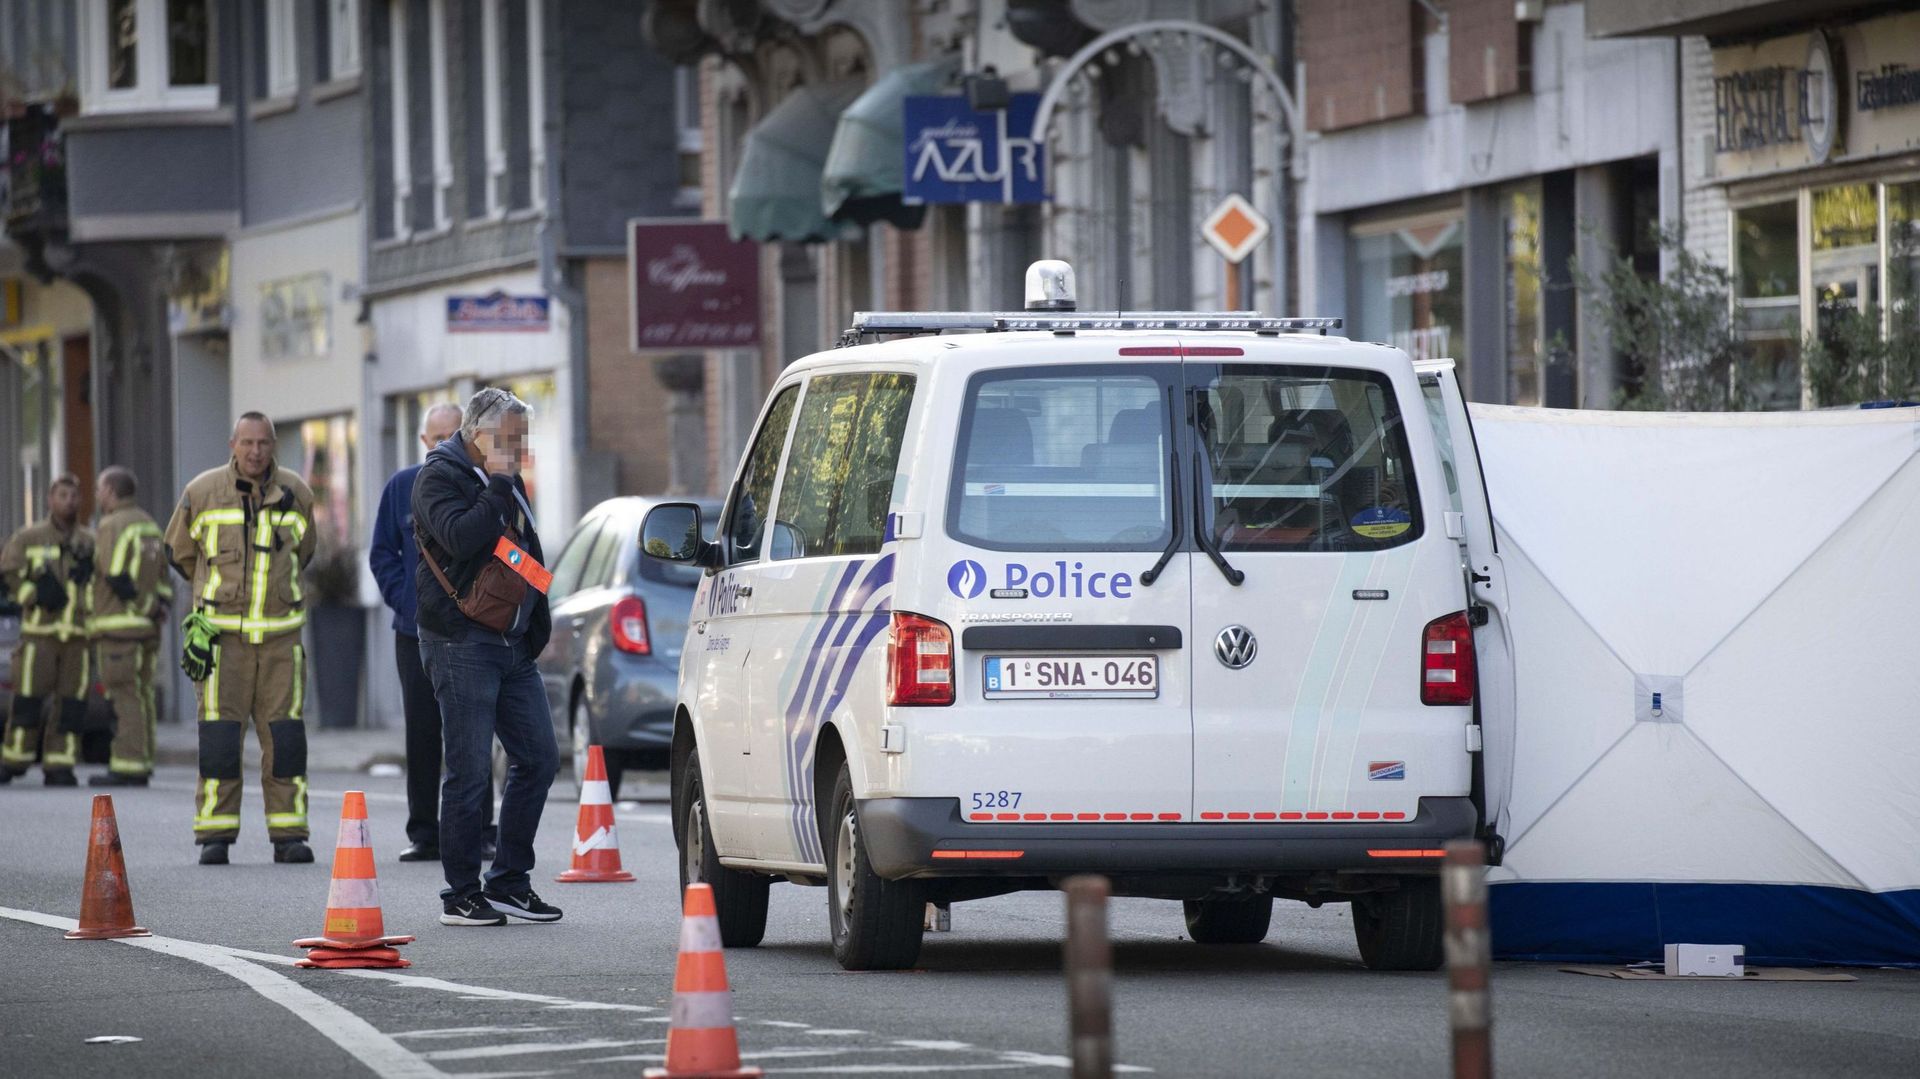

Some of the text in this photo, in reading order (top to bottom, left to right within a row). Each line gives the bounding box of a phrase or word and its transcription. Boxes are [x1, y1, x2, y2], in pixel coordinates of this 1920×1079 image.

[1006, 561, 1132, 599] Police
[959, 611, 1073, 623] TRANSPORTER
[988, 678, 999, 689] B
[972, 790, 1022, 810] 5287
